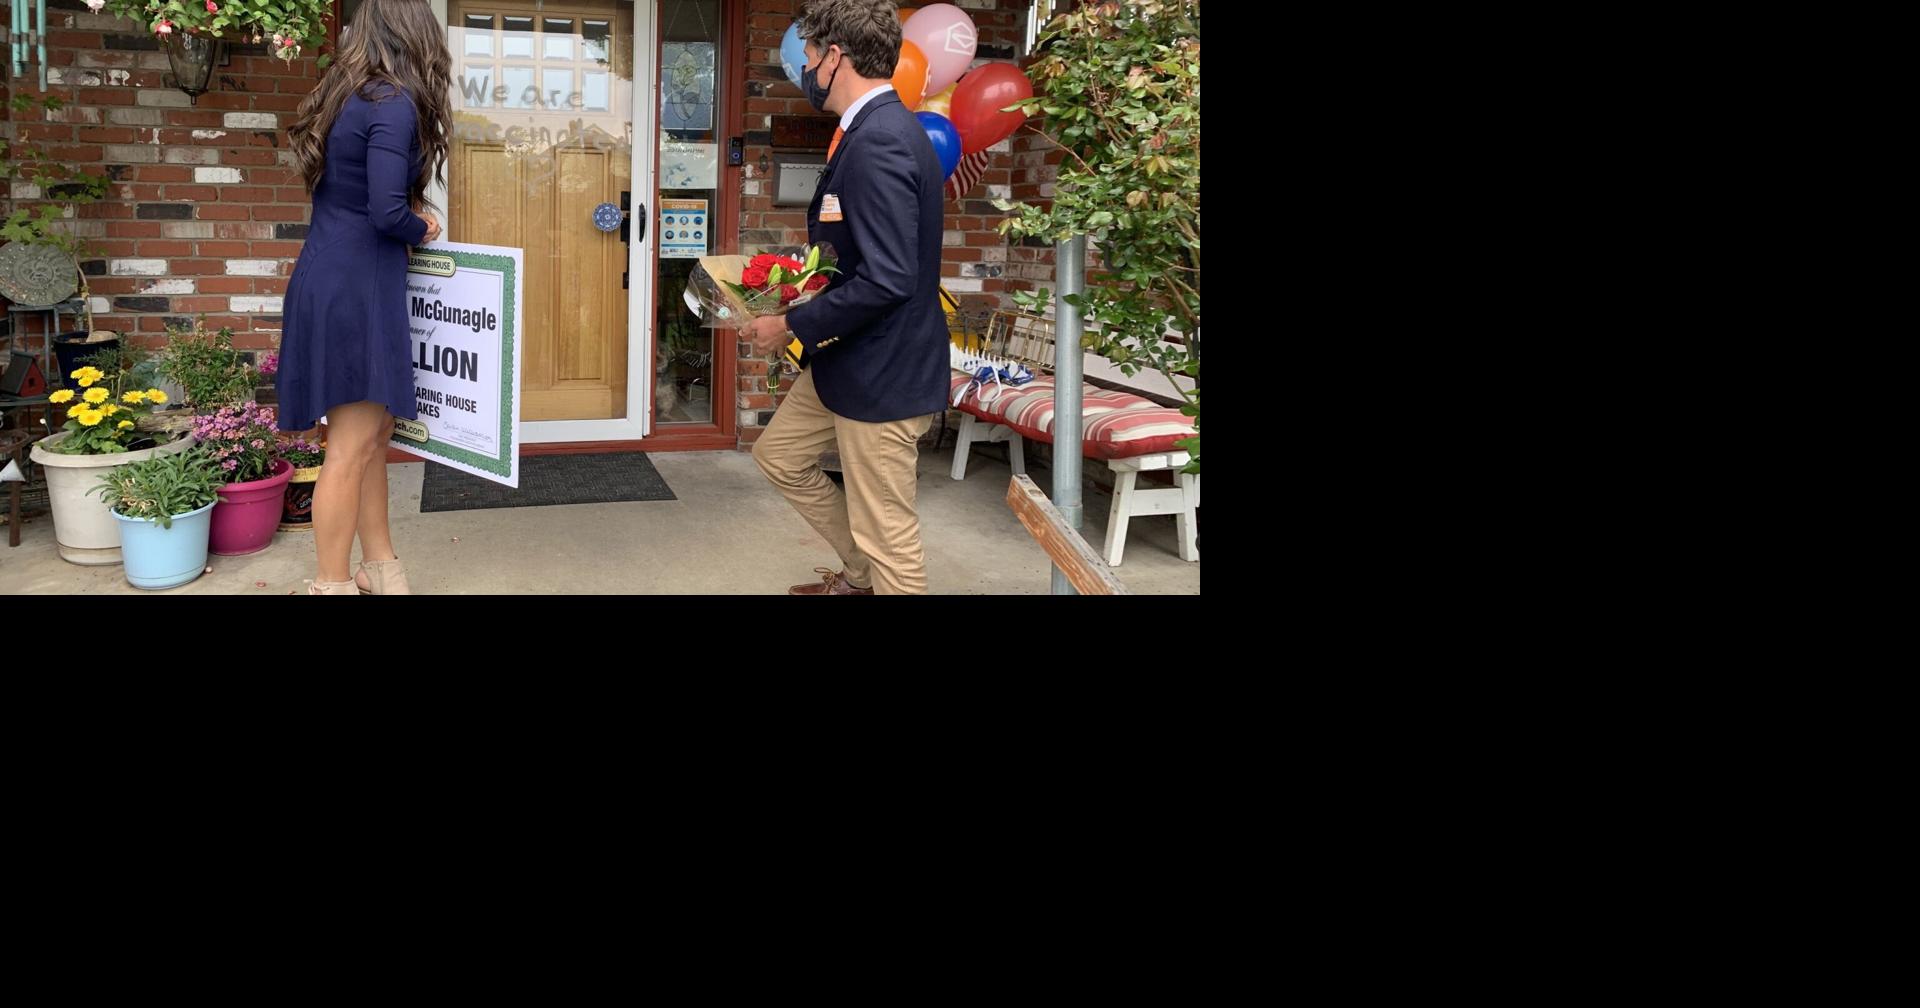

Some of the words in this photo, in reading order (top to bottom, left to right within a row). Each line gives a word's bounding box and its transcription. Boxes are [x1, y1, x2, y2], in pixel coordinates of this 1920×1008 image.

[457, 74, 511, 104] We
[520, 84, 585, 108] are
[431, 260, 451, 271] HOUSE
[412, 296, 496, 333] McGunagle
[412, 341, 478, 382] LION
[445, 394, 477, 413] HOUSE
